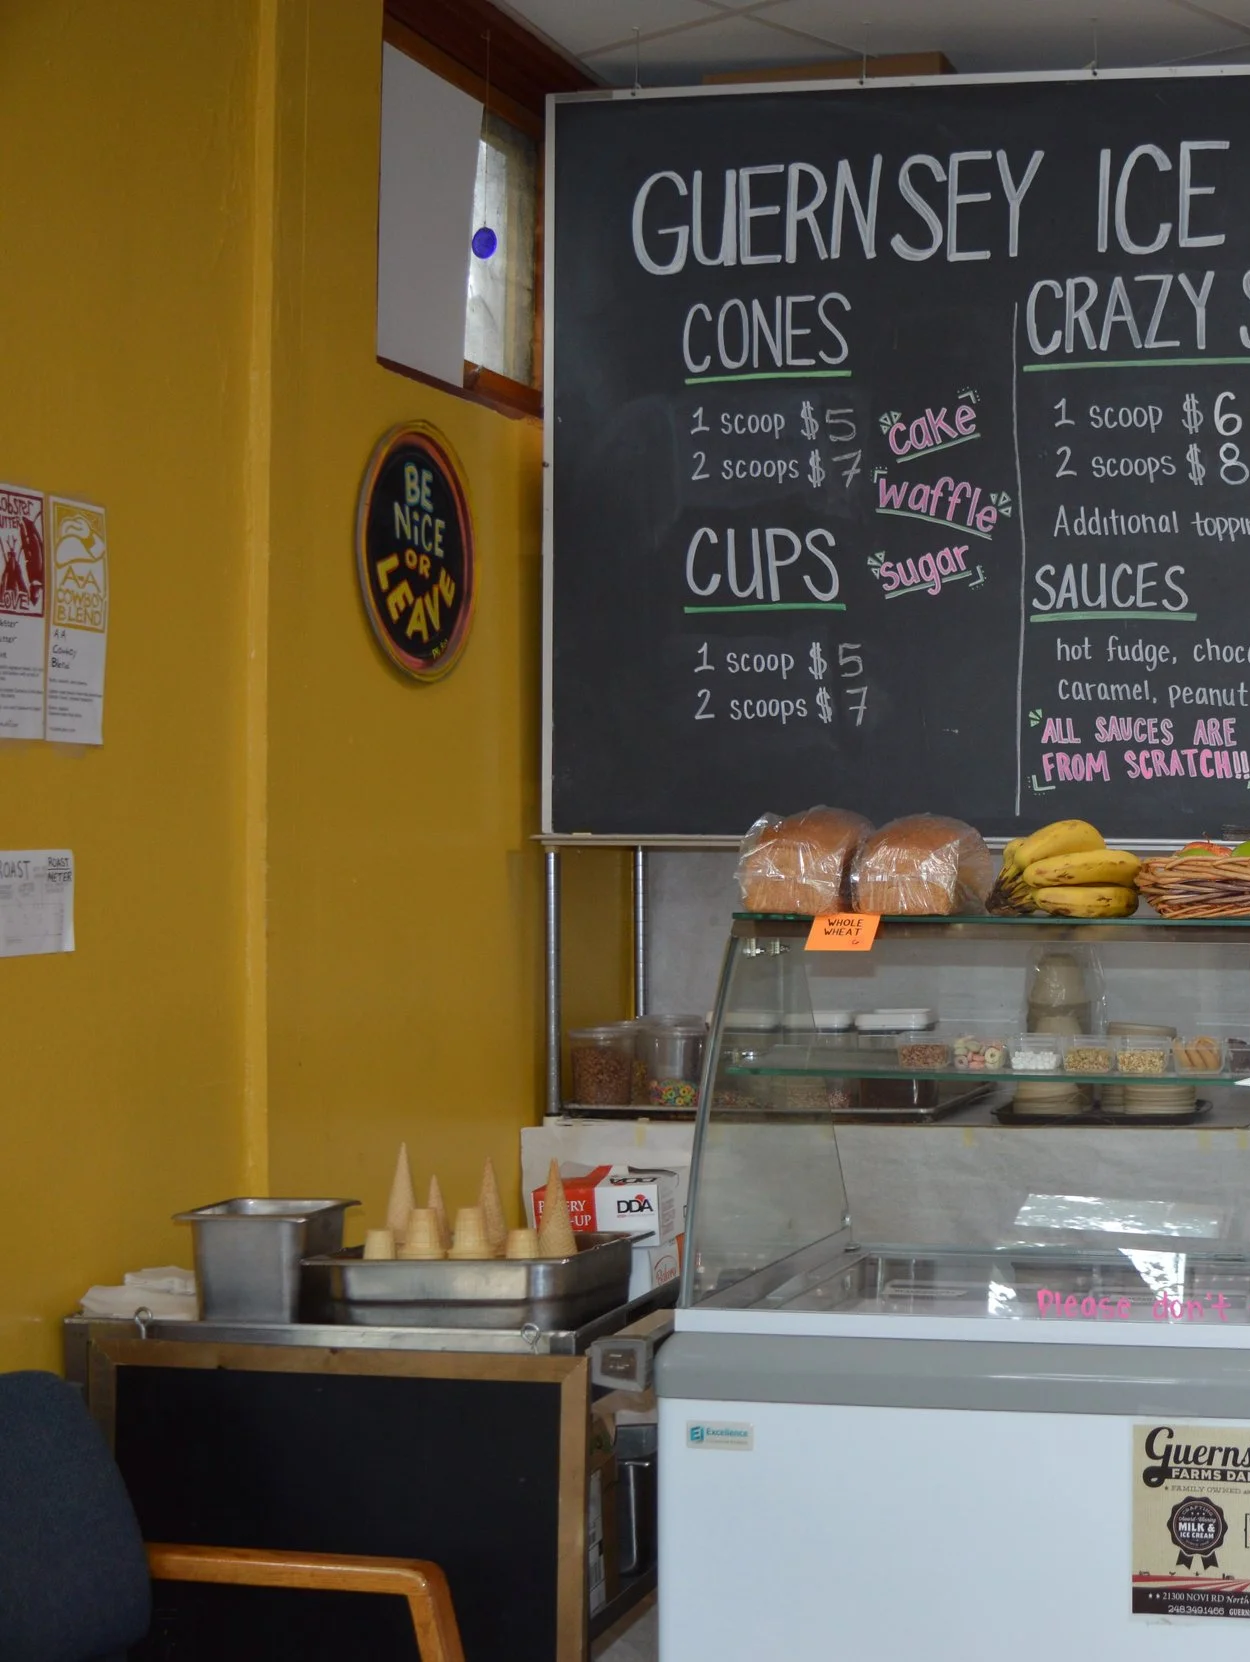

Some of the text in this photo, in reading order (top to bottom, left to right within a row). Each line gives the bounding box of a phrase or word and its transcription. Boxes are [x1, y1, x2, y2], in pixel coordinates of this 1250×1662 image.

[632, 149, 1045, 276] GUERNSEY
[1097, 139, 1230, 255] ICE
[1026, 269, 1215, 356] CRAZY
[683, 292, 852, 373] CONES
[691, 407, 710, 434] 1
[721, 413, 785, 439] scoop
[889, 405, 977, 455] cake
[691, 451, 710, 481] 2
[721, 459, 800, 484] scoops
[404, 462, 433, 513] BE
[879, 476, 998, 533] waffle
[1054, 505, 1179, 537] Additional
[405, 548, 430, 579] OR
[685, 527, 840, 602] CUPS
[879, 544, 969, 596] sugar
[377, 552, 455, 643] LEAVE
[1032, 562, 1190, 612] SAUCES
[1056, 636, 1092, 662] hot
[1107, 635, 1178, 671] fudge,
[1168, 682, 1248, 708] peanut
[1041, 717, 1081, 744] ALL
[1095, 716, 1174, 746] SAUCES
[1193, 717, 1237, 747] ARE
[1042, 750, 1111, 782] FROM
[824, 928, 861, 936] WHEAT
[828, 919, 864, 927] WHOLE
[617, 1199, 653, 1214] DDA
[1036, 1289, 1131, 1319] Please
[1171, 1468, 1222, 1481] FARMS
[1179, 1522, 1205, 1532] MILK
[1186, 1593, 1209, 1602] NOVI
